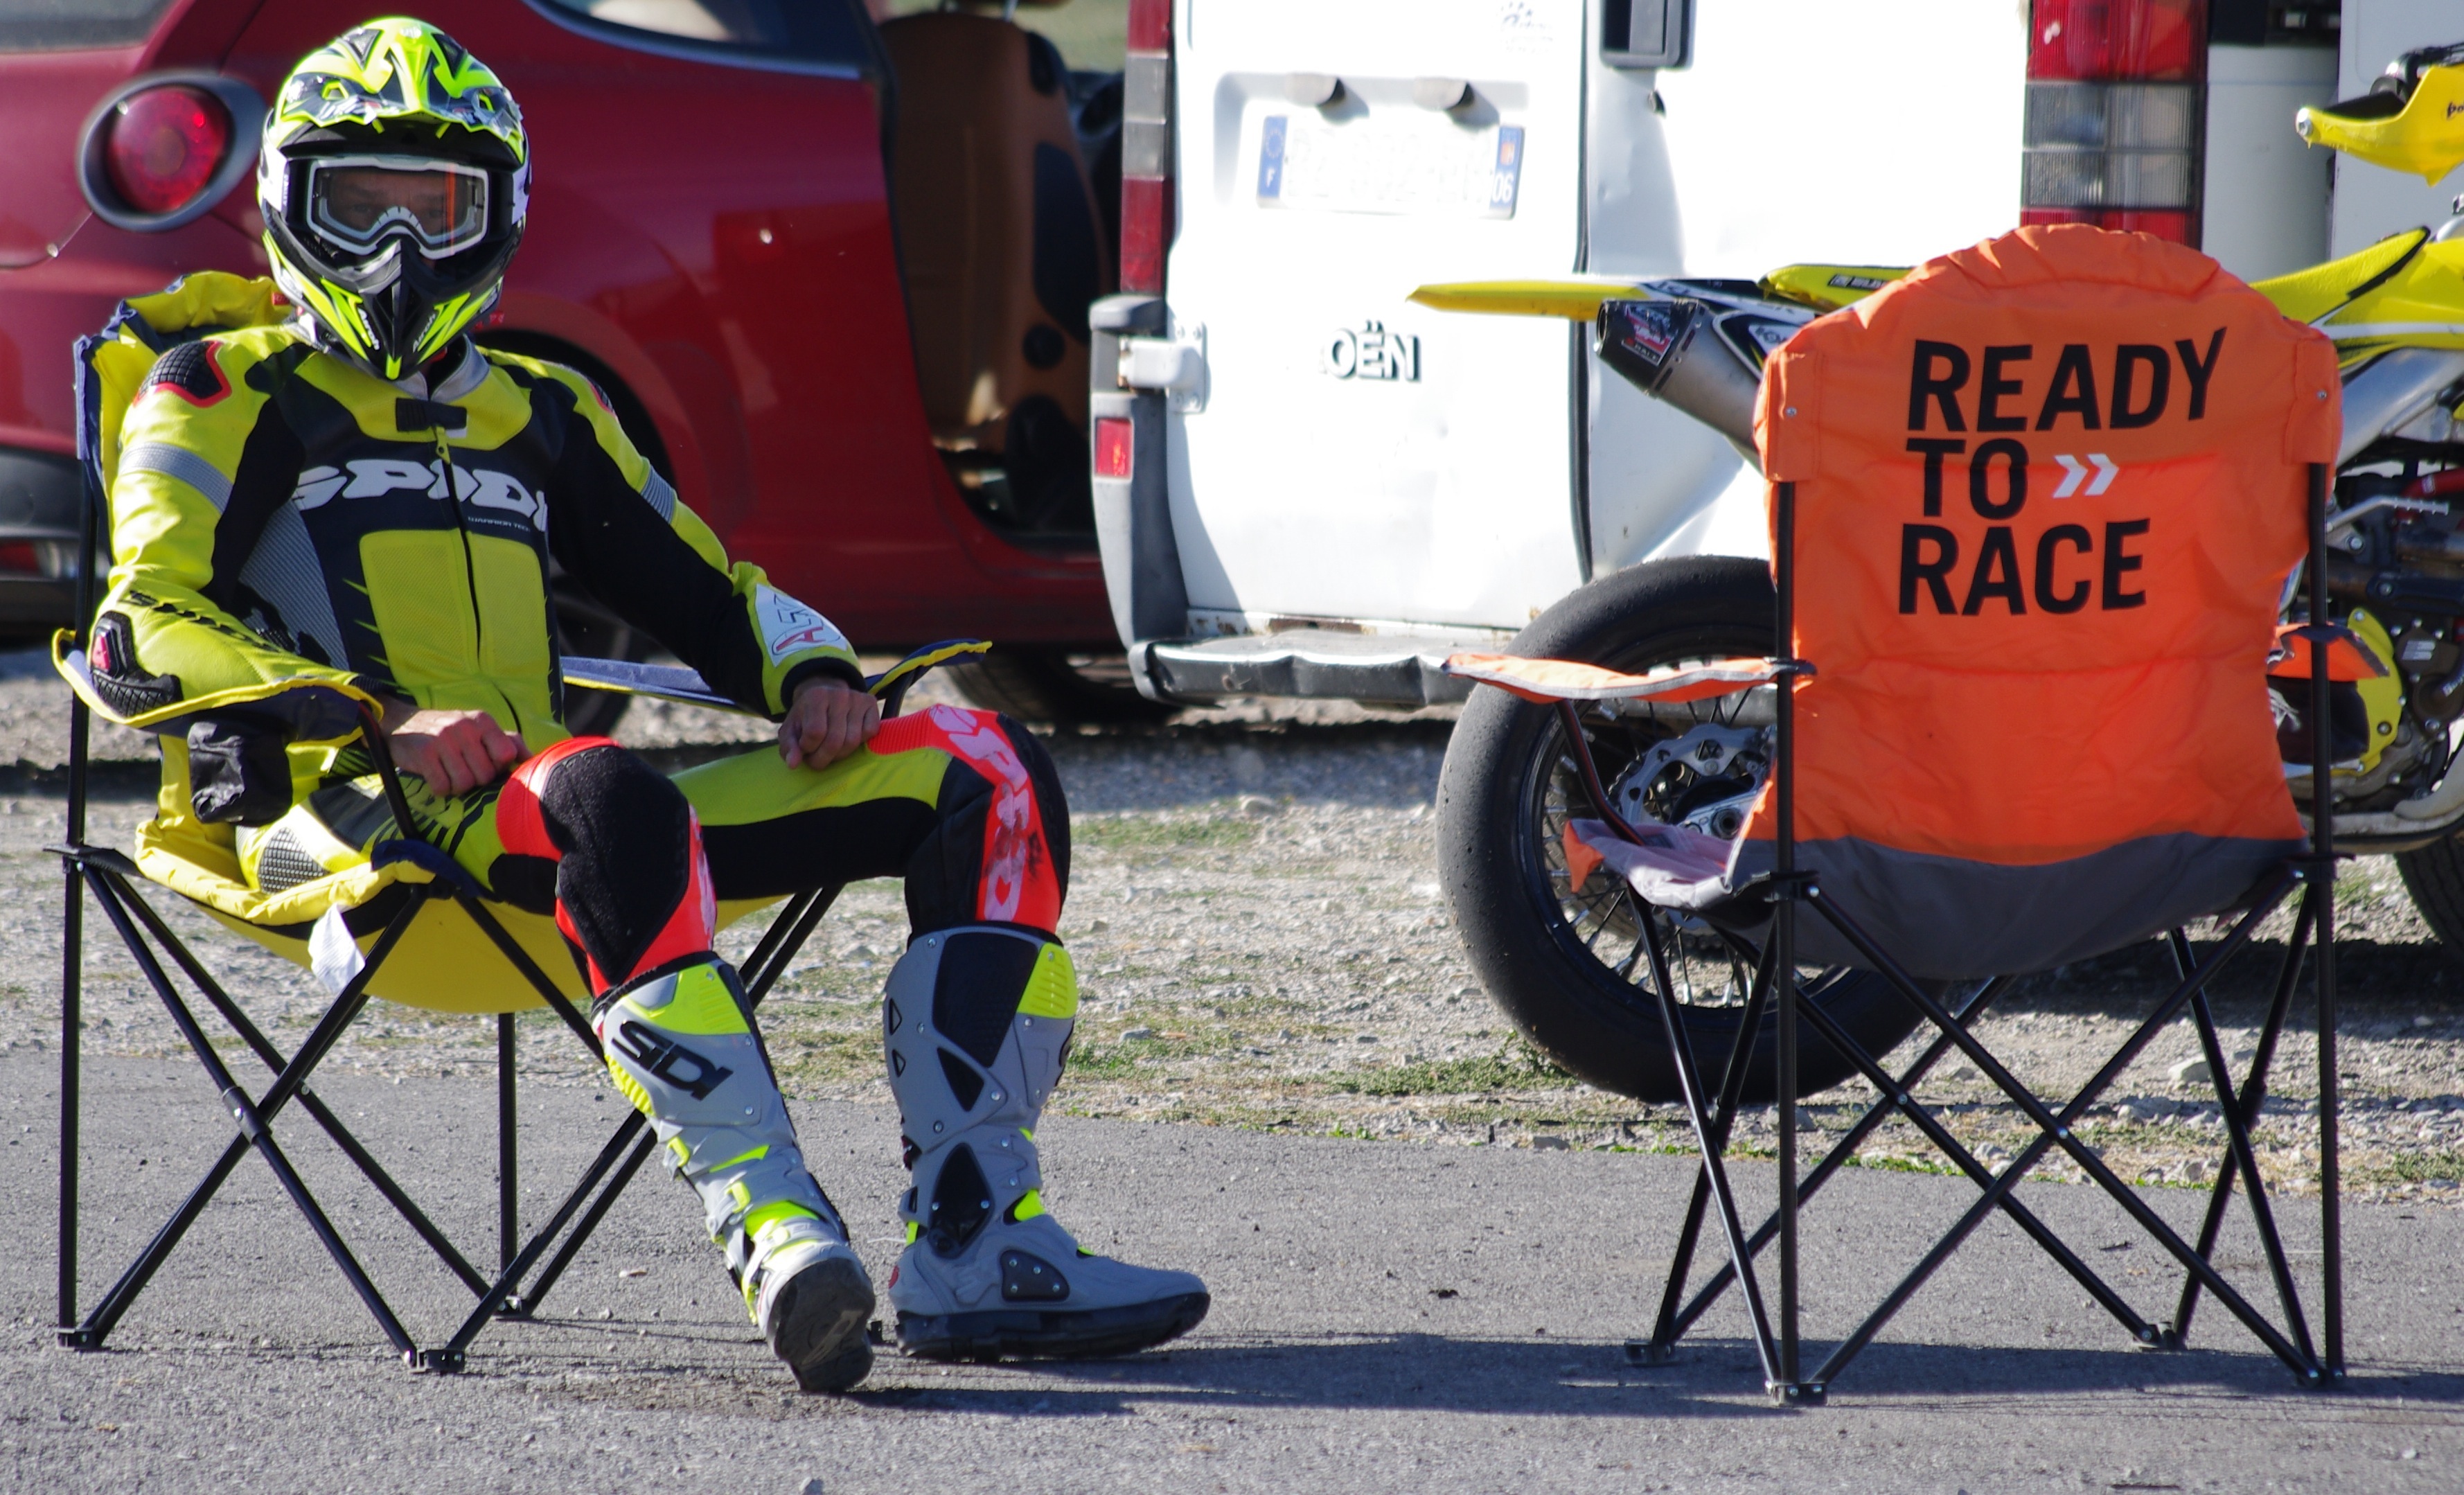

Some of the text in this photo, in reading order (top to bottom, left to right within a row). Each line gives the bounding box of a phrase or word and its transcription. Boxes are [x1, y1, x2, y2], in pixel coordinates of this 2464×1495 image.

[1493, 172, 1514, 204] 06
[1908, 326, 2228, 432] READY
[1906, 438, 2030, 520] TO
[1899, 518, 2151, 617] RACE
